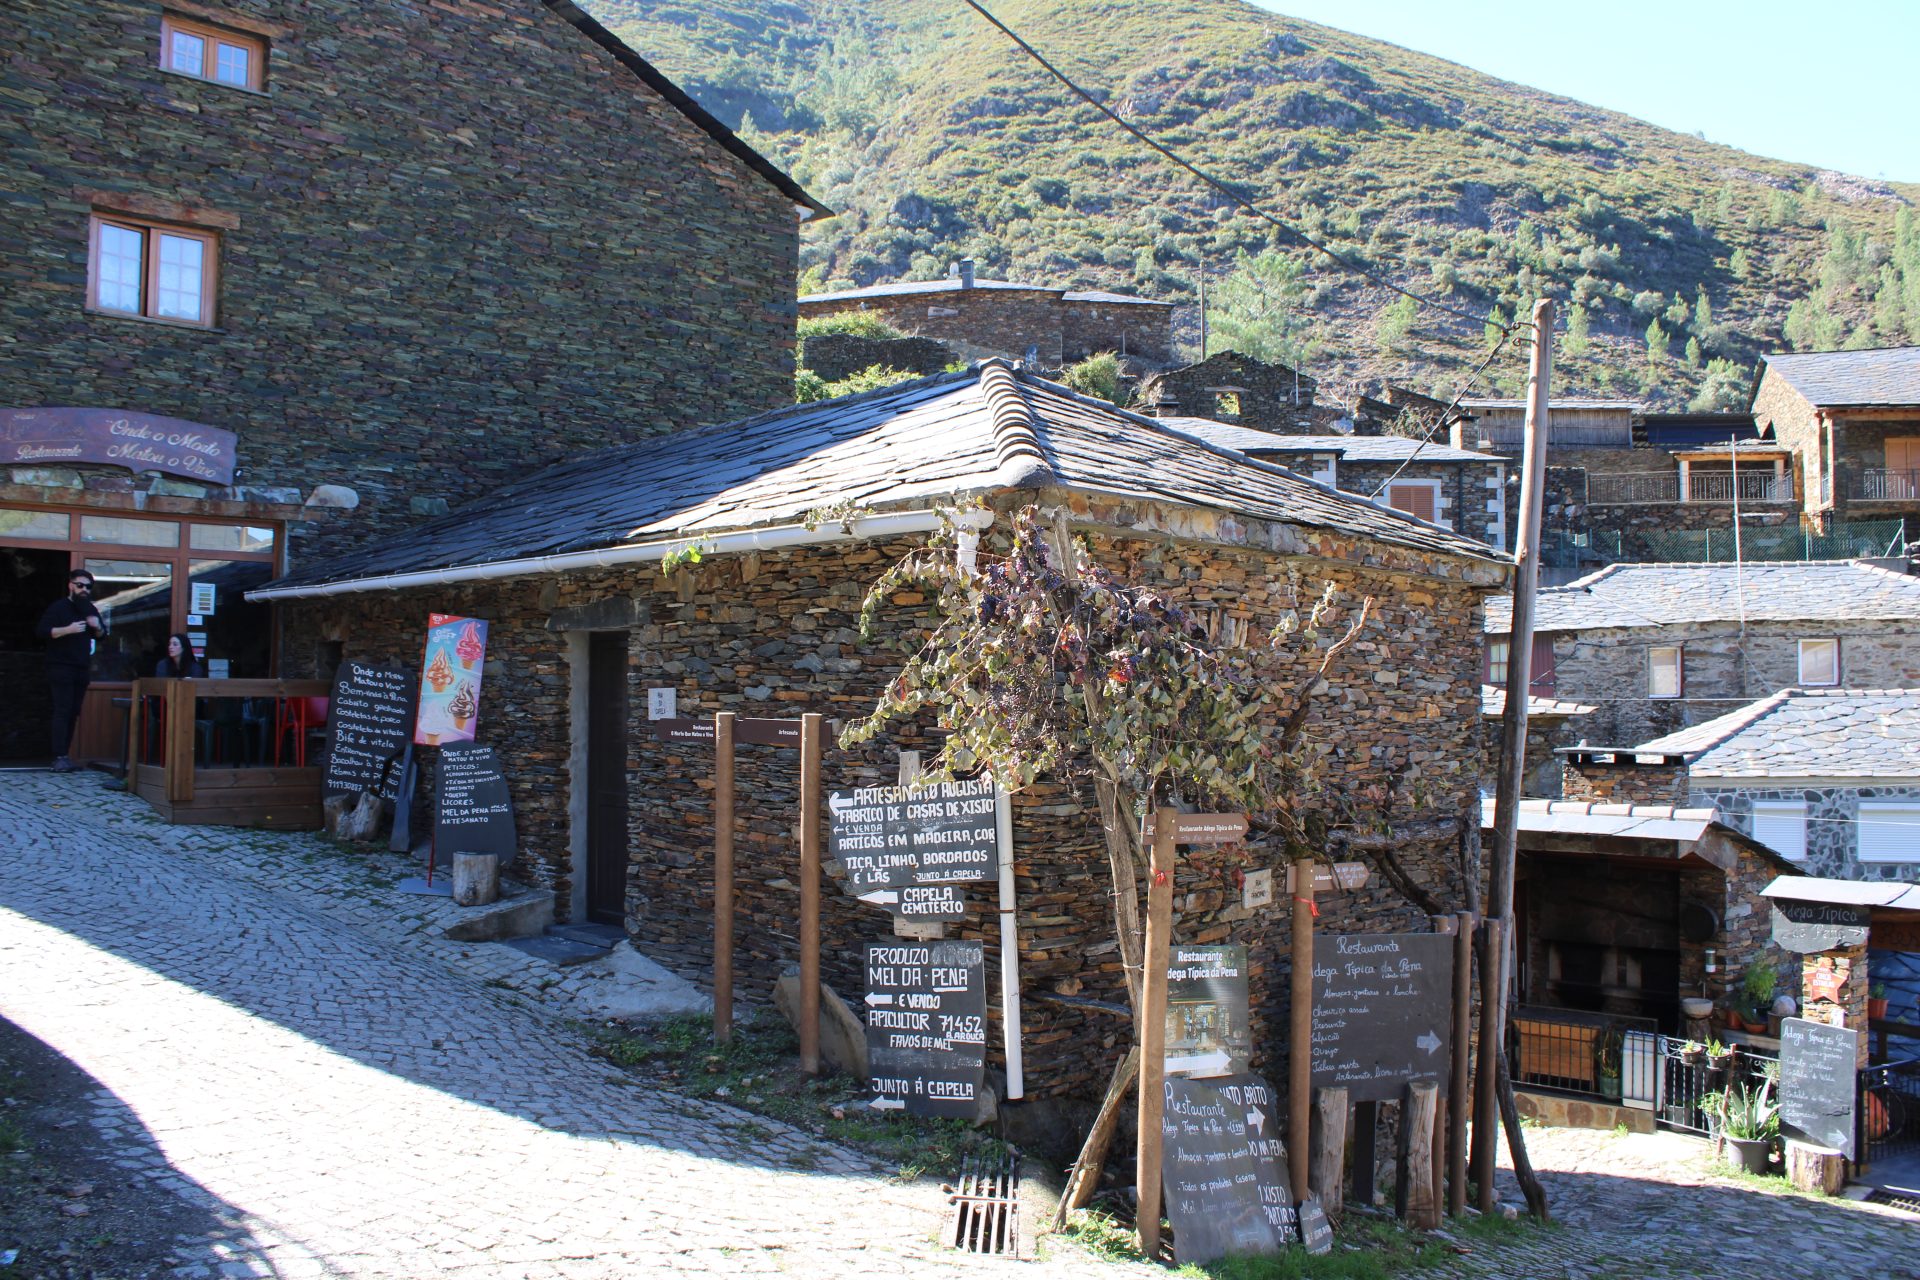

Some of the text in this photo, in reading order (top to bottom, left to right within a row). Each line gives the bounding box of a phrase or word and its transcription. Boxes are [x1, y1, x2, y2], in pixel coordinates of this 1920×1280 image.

[14, 444, 82, 460] Restaurante
[107, 443, 164, 464] Matou
[167, 457, 179, 466] o
[336, 729, 355, 744] Bife
[358, 736, 367, 744] de
[441, 808, 459, 817] MEL
[471, 807, 489, 815] PENA
[839, 807, 884, 824] FABRICO
[888, 806, 900, 821] DE
[907, 802, 944, 820] CASAS
[946, 803, 959, 817] DE
[441, 817, 489, 825] ARTESANATO
[853, 824, 883, 834] VENDA
[839, 836, 885, 851] ARTIGOS
[888, 835, 908, 847] EM
[914, 830, 974, 845] MADEIRA,
[845, 850, 988, 872] TIÇA, LINHO, BORDADOS
[854, 868, 890, 884] E LÃS
[903, 887, 952, 902] CAPELA
[1337, 936, 1400, 954] Restaurante
[869, 948, 929, 965] PRODUZO
[1178, 951, 1223, 962] Restaurante
[869, 967, 968, 986] MEL DA PENA
[1167, 966, 1238, 981] dega Típica da Pena
[1311, 962, 1339, 984] dega
[1381, 961, 1392, 973] da
[1399, 958, 1422, 973] Pena
[899, 994, 941, 1009] E VENDO
[869, 1010, 930, 1030] APICULTOR
[1312, 1018, 1347, 1030] Presunto
[890, 1035, 953, 1051] FAVOS DE MEL
[1782, 1025, 1804, 1047] Adega
[872, 1078, 908, 1094] JUNTO
[928, 1081, 974, 1096] CAPELA
[1164, 1081, 1227, 1117] Restaurante
[1180, 1182, 1197, 1192] Todos
[1200, 1183, 1207, 1191] os
